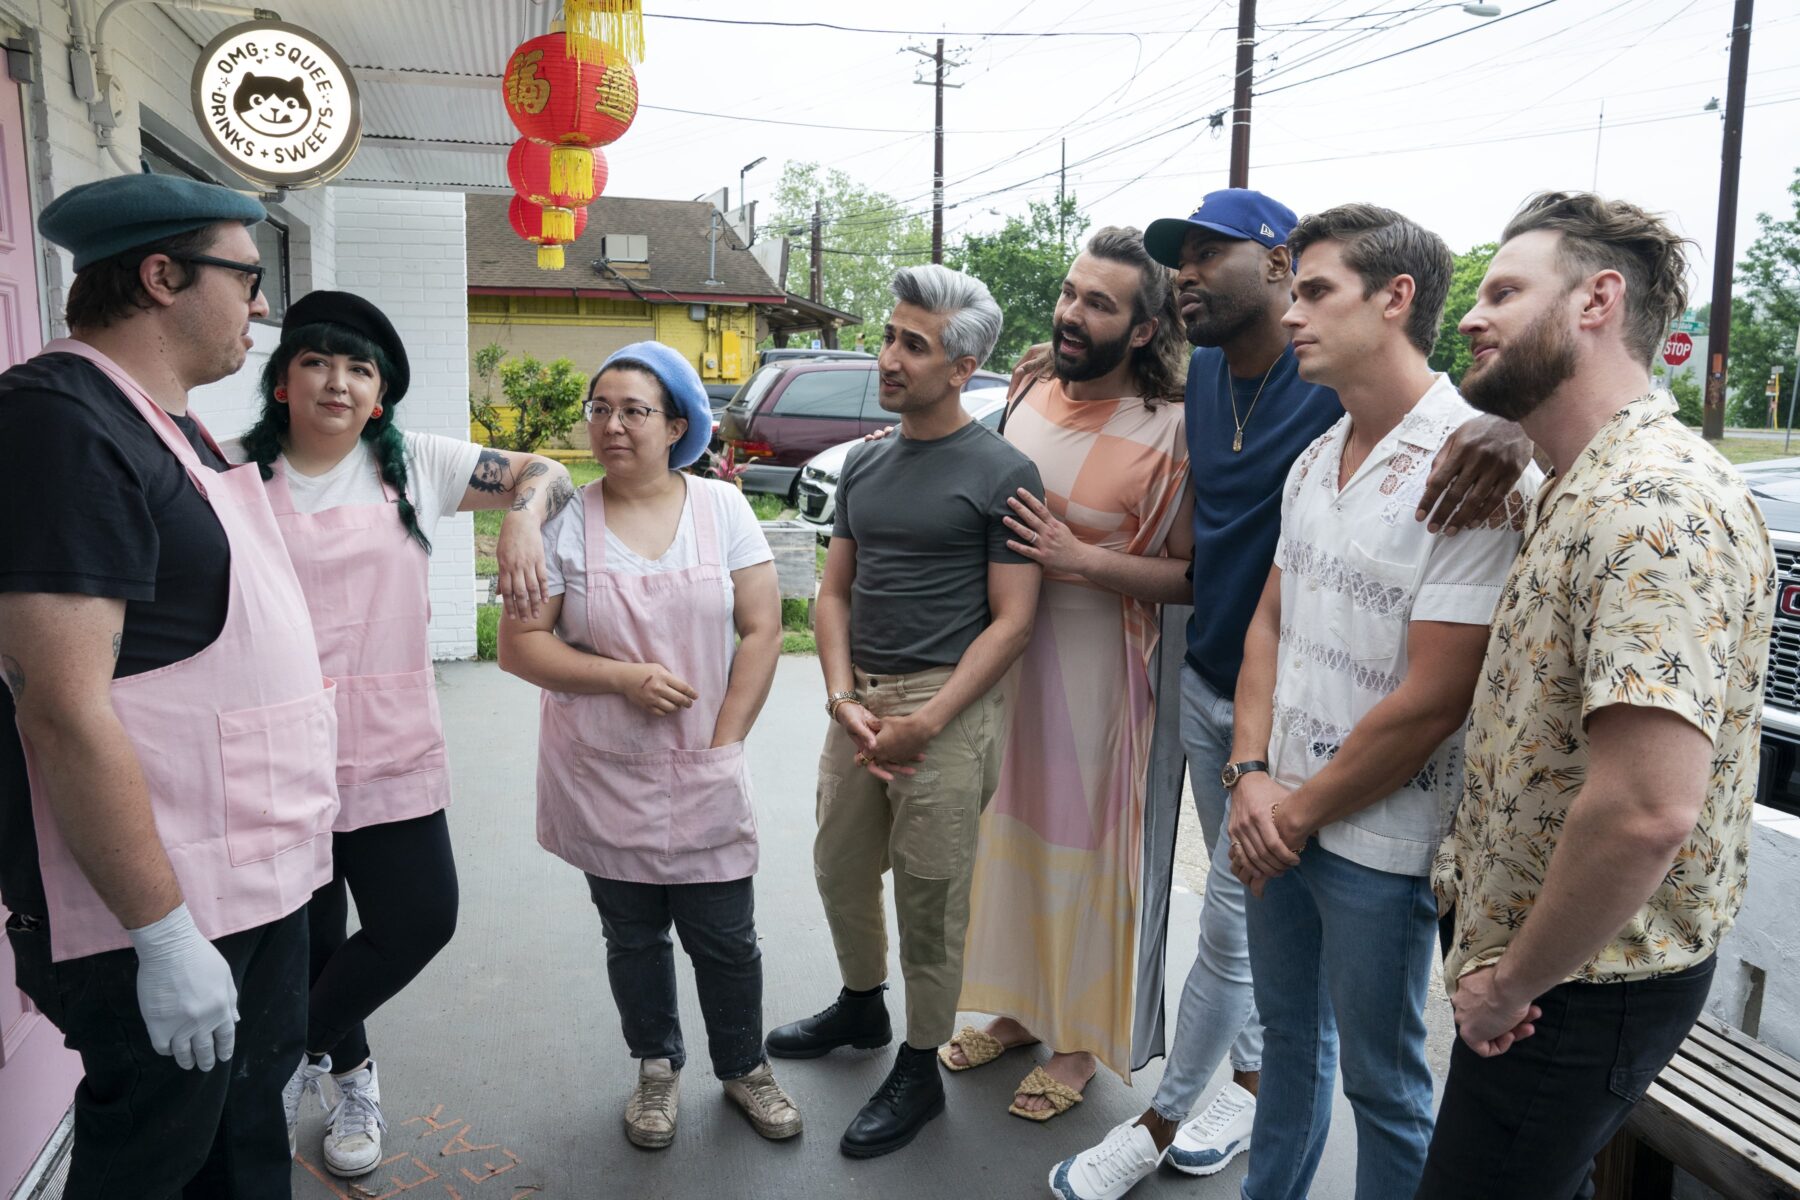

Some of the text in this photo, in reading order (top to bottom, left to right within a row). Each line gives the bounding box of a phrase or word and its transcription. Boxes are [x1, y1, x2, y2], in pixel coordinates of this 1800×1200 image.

[217, 42, 333, 93] OMG SQUEE
[211, 92, 256, 157] DRINKS
[274, 107, 333, 164] SWEETS
[1664, 342, 1691, 356] STOP
